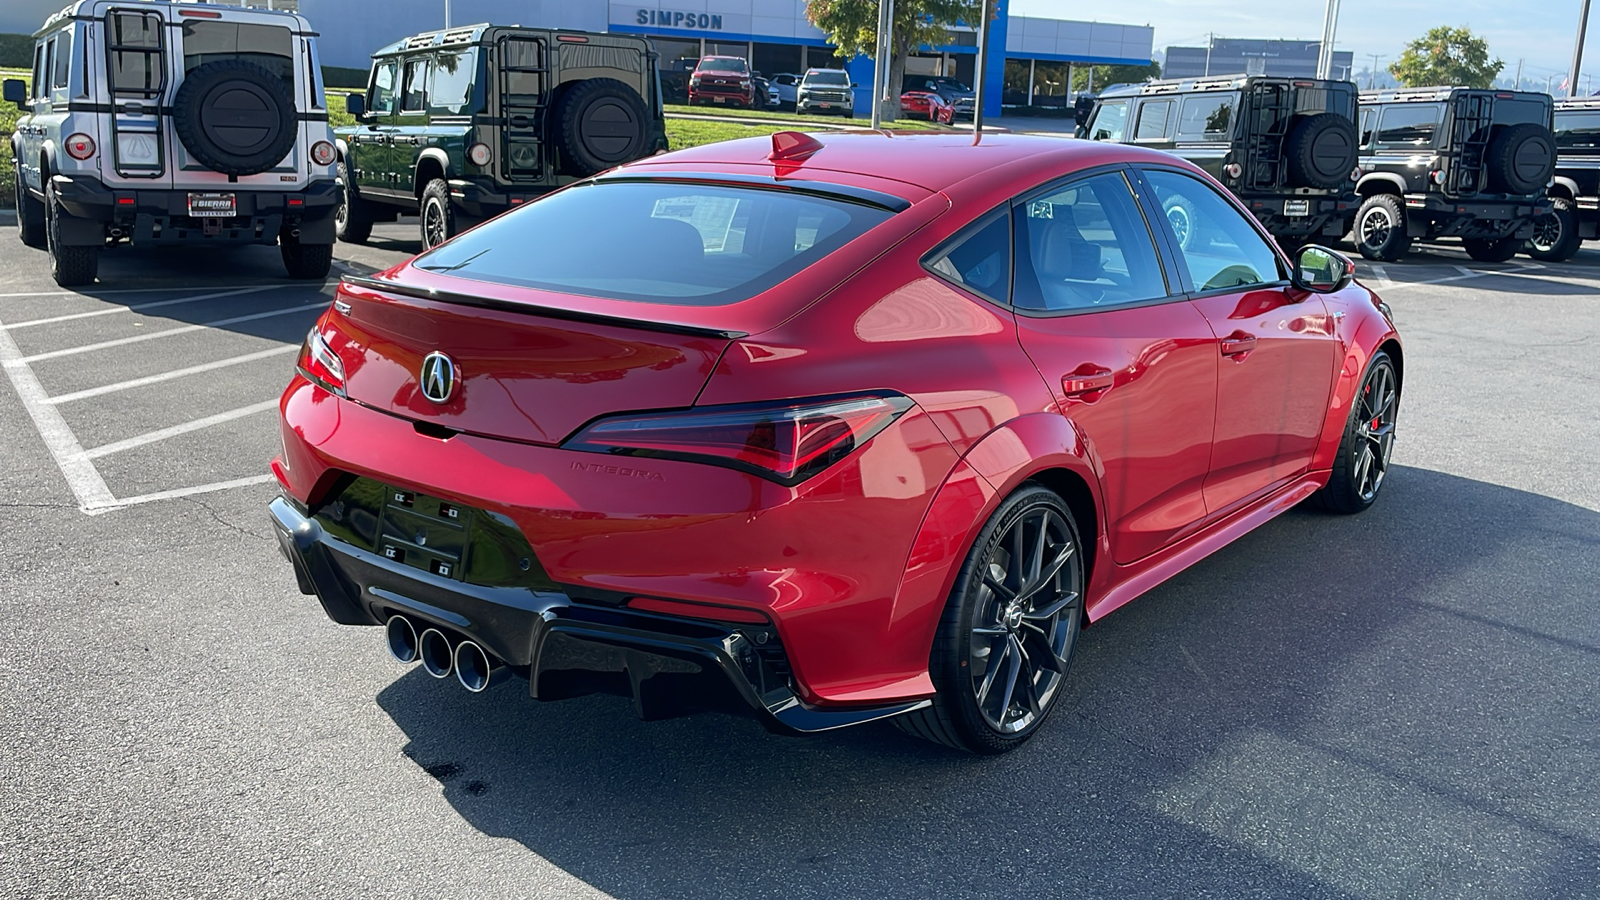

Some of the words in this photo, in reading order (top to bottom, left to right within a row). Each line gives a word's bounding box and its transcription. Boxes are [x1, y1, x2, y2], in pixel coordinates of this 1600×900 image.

[637, 9, 722, 30] SIMPSON
[570, 461, 666, 482] INTEGRA
[972, 523, 1002, 589] MICHELIN
